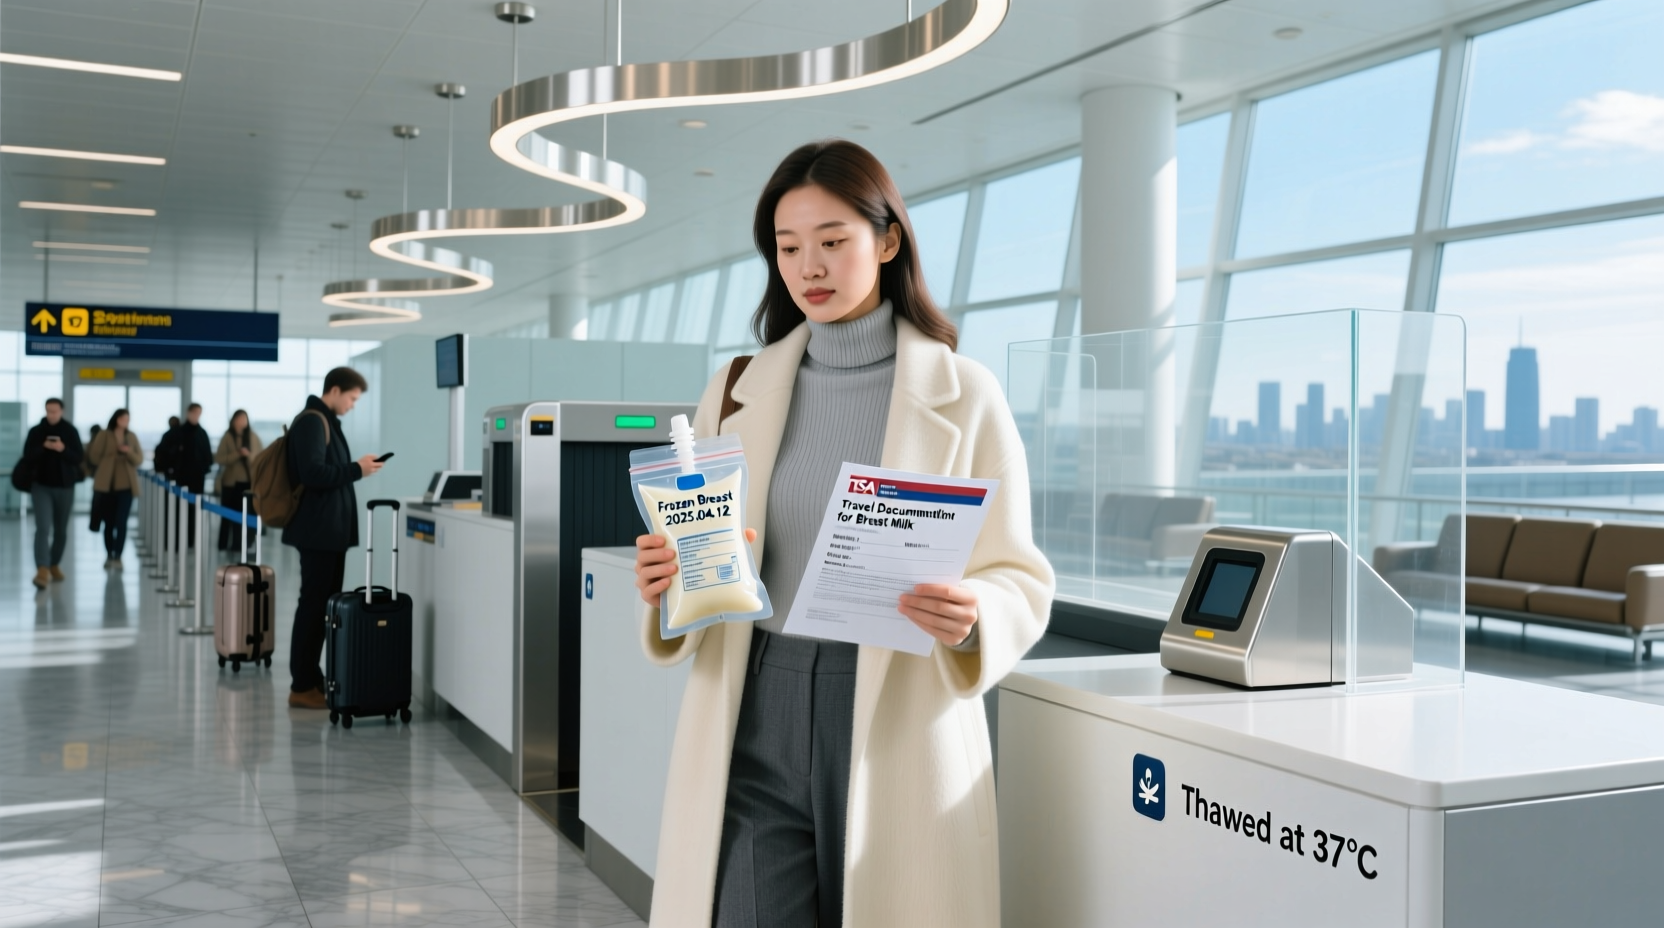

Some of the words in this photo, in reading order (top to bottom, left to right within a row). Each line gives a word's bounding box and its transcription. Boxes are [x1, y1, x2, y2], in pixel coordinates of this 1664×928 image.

[850, 478, 875, 496] TSA
[697, 489, 733, 506] Breast
[842, 499, 875, 513] Travel
[837, 511, 853, 522] for
[890, 517, 915, 530] Milk
[1181, 783, 1272, 844] Thawed
[1279, 823, 1305, 856] at
[1312, 828, 1378, 880] 37°C
